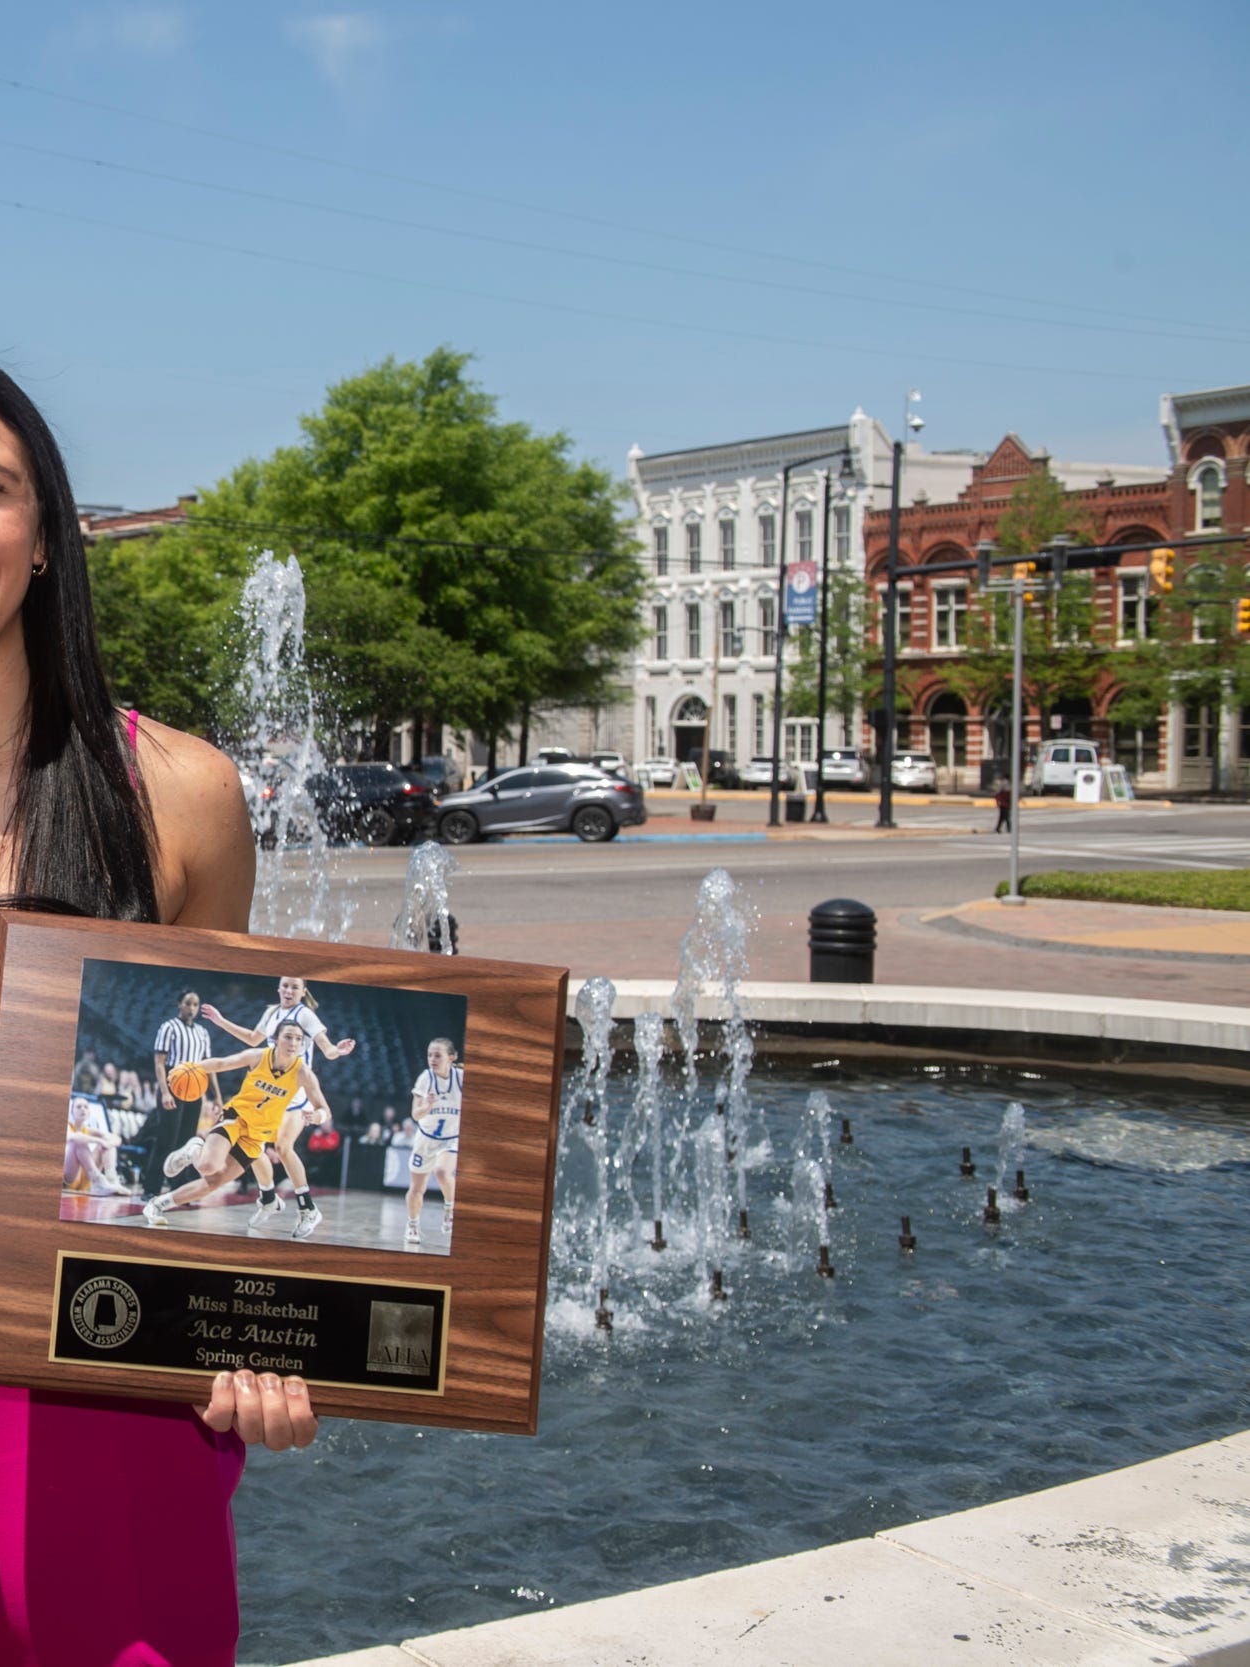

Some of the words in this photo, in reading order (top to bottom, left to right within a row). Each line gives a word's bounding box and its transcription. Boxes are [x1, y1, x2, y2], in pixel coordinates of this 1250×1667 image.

[254, 1080, 288, 1098] GARDEN
[433, 1119, 446, 1137] 1
[412, 1153, 423, 1168] B
[77, 1280, 111, 1304] ALABAMA
[112, 1281, 136, 1308] SPORTS
[234, 1279, 276, 1297] 2025
[187, 1295, 228, 1313] Miss
[231, 1299, 319, 1320] Basketball
[74, 1306, 95, 1341] WRITERS
[95, 1311, 137, 1345] ASSOCIATION
[188, 1320, 232, 1340] Ace
[238, 1324, 318, 1348] Austin
[196, 1347, 245, 1369] Spring
[249, 1352, 303, 1370] Garden
